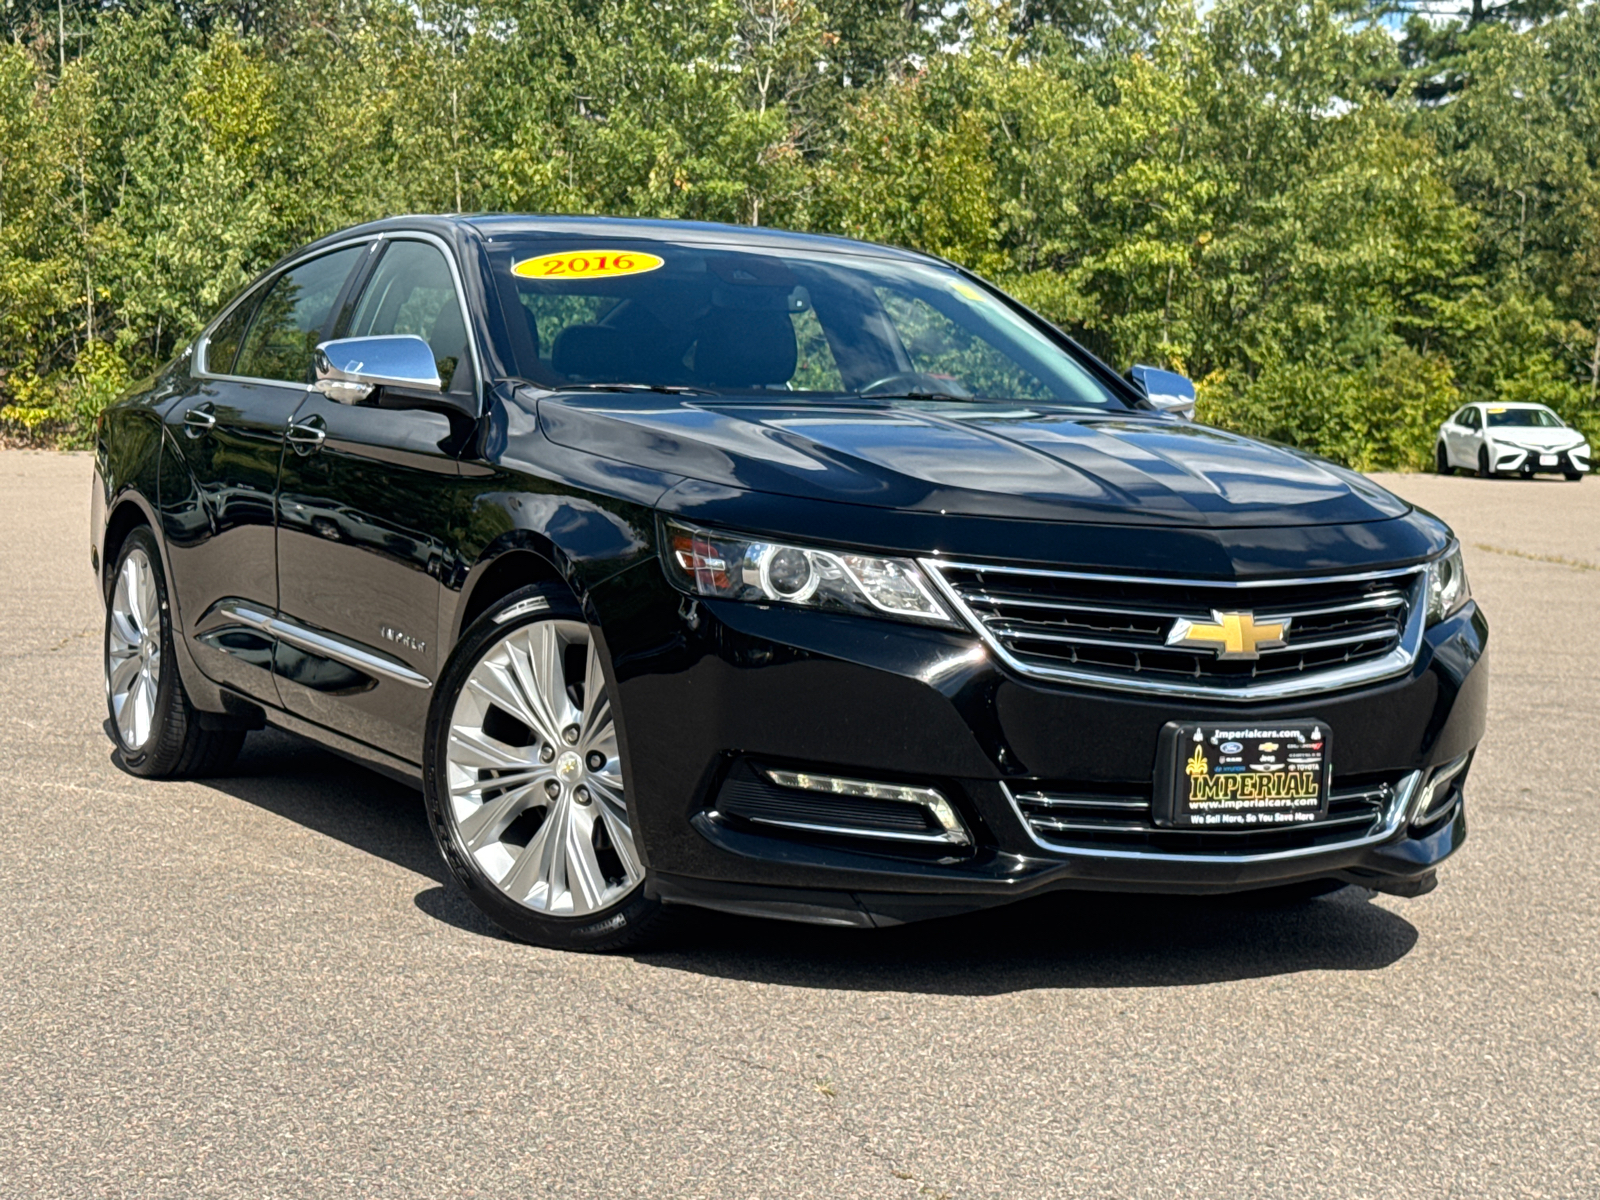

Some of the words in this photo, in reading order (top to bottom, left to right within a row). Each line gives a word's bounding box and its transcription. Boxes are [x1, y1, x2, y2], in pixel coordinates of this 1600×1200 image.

[543, 254, 635, 275] 2016
[1215, 729, 1300, 740] Imperialcars.com
[1189, 772, 1319, 801] IMPERIAL
[1190, 815, 1204, 824] We
[1205, 814, 1220, 824] Sell
[1246, 813, 1257, 822] So
[1258, 813, 1273, 822] You
[1274, 812, 1293, 822] Save
[1294, 811, 1315, 821] More
